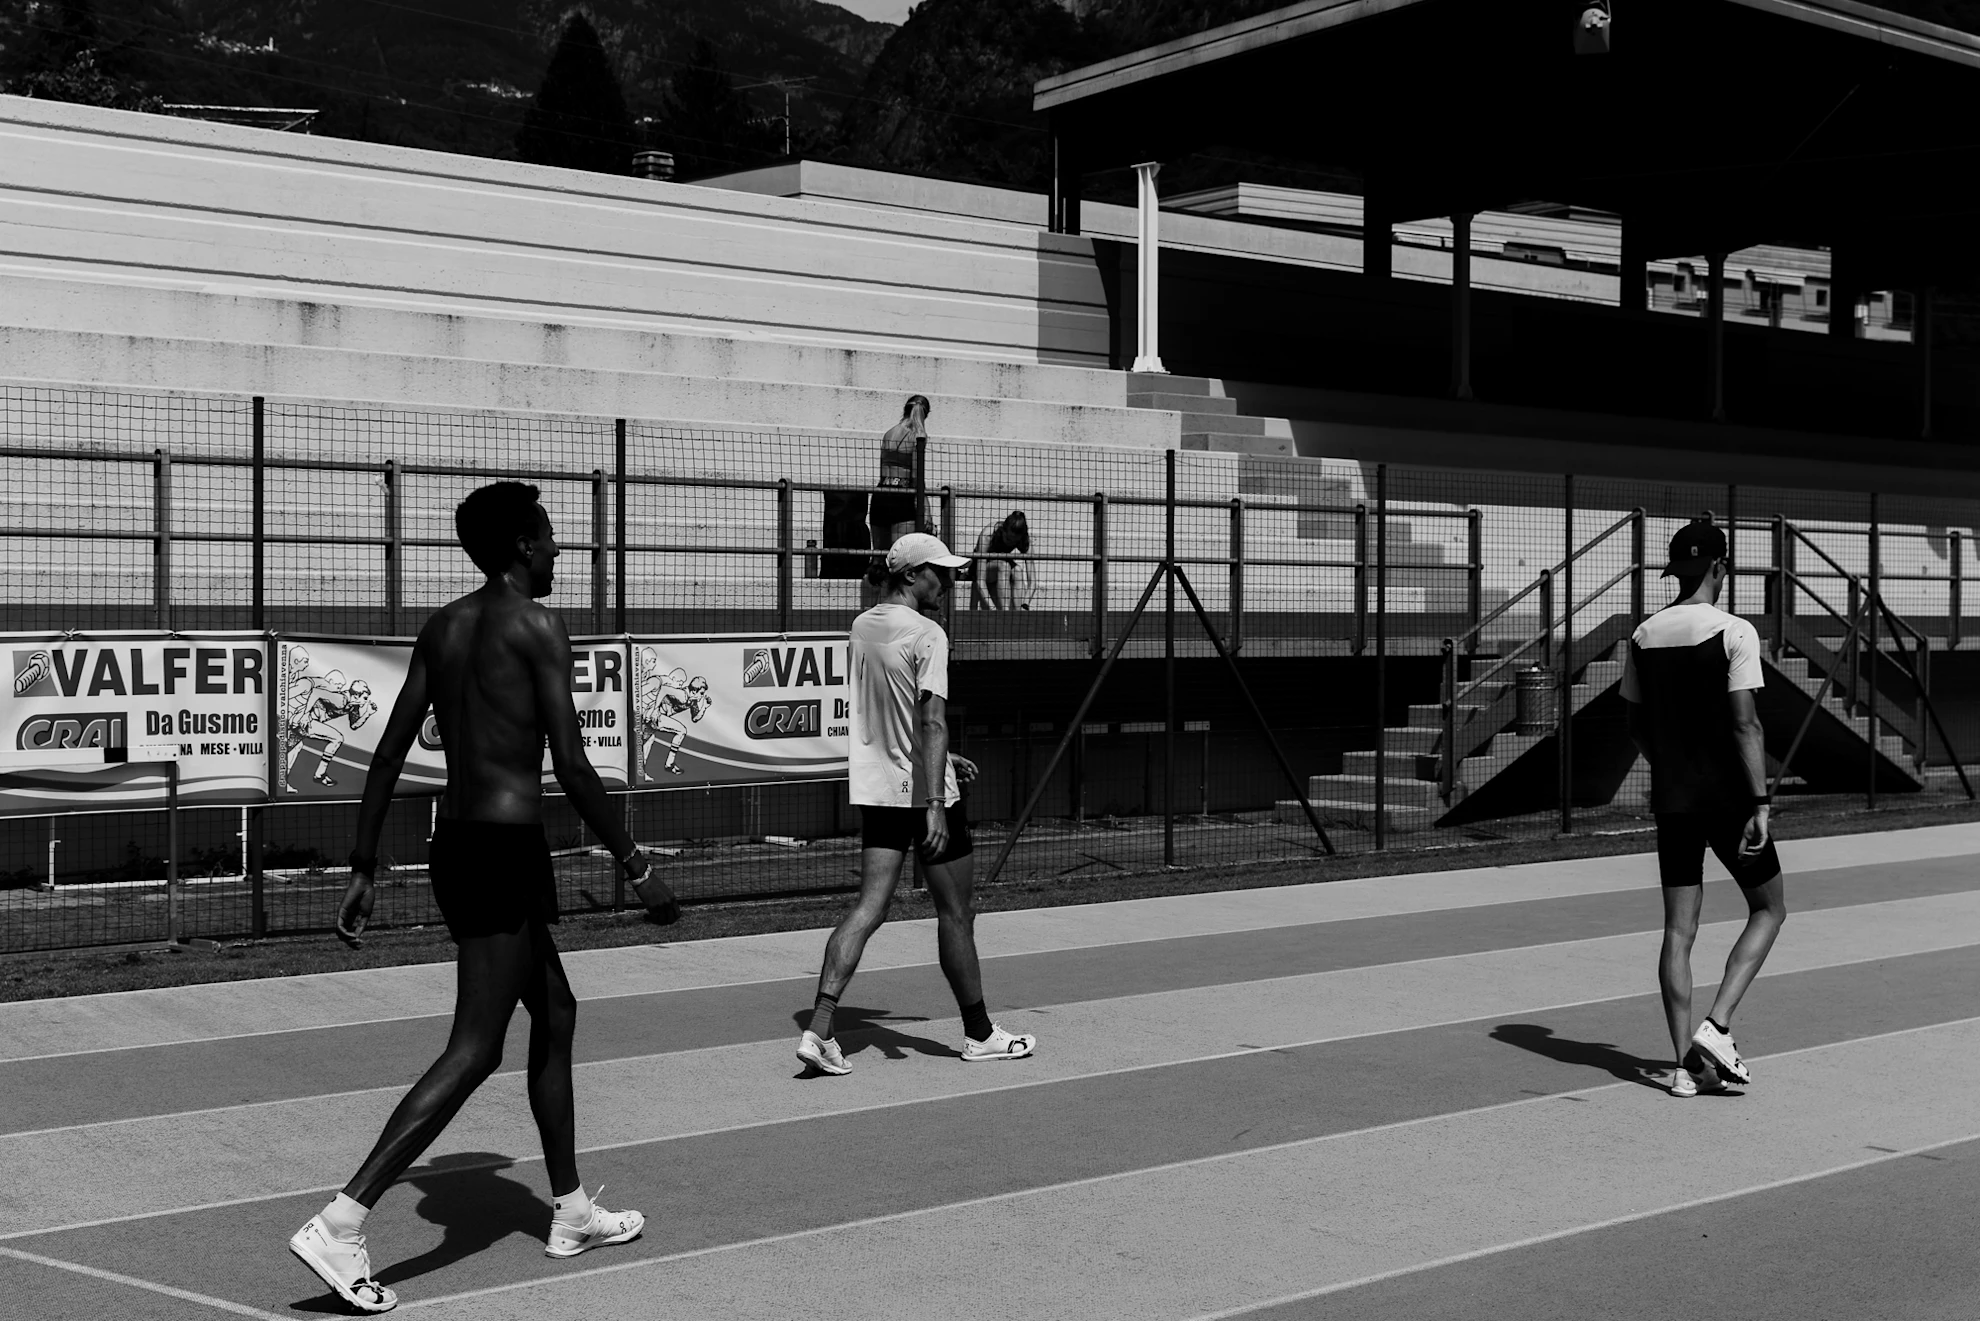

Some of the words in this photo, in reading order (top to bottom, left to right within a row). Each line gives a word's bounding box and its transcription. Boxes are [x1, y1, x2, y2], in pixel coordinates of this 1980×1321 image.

[51, 648, 263, 697] VALFER
[279, 644, 288, 707] valchiavenna
[770, 646, 849, 687] VAL
[146, 710, 173, 736] Da
[178, 708, 258, 735] Gusme
[577, 708, 617, 729] sme
[747, 705, 818, 735] CRAI
[200, 742, 231, 755] MESE
[238, 742, 264, 755] VILLA
[598, 736, 623, 748] VILLA
